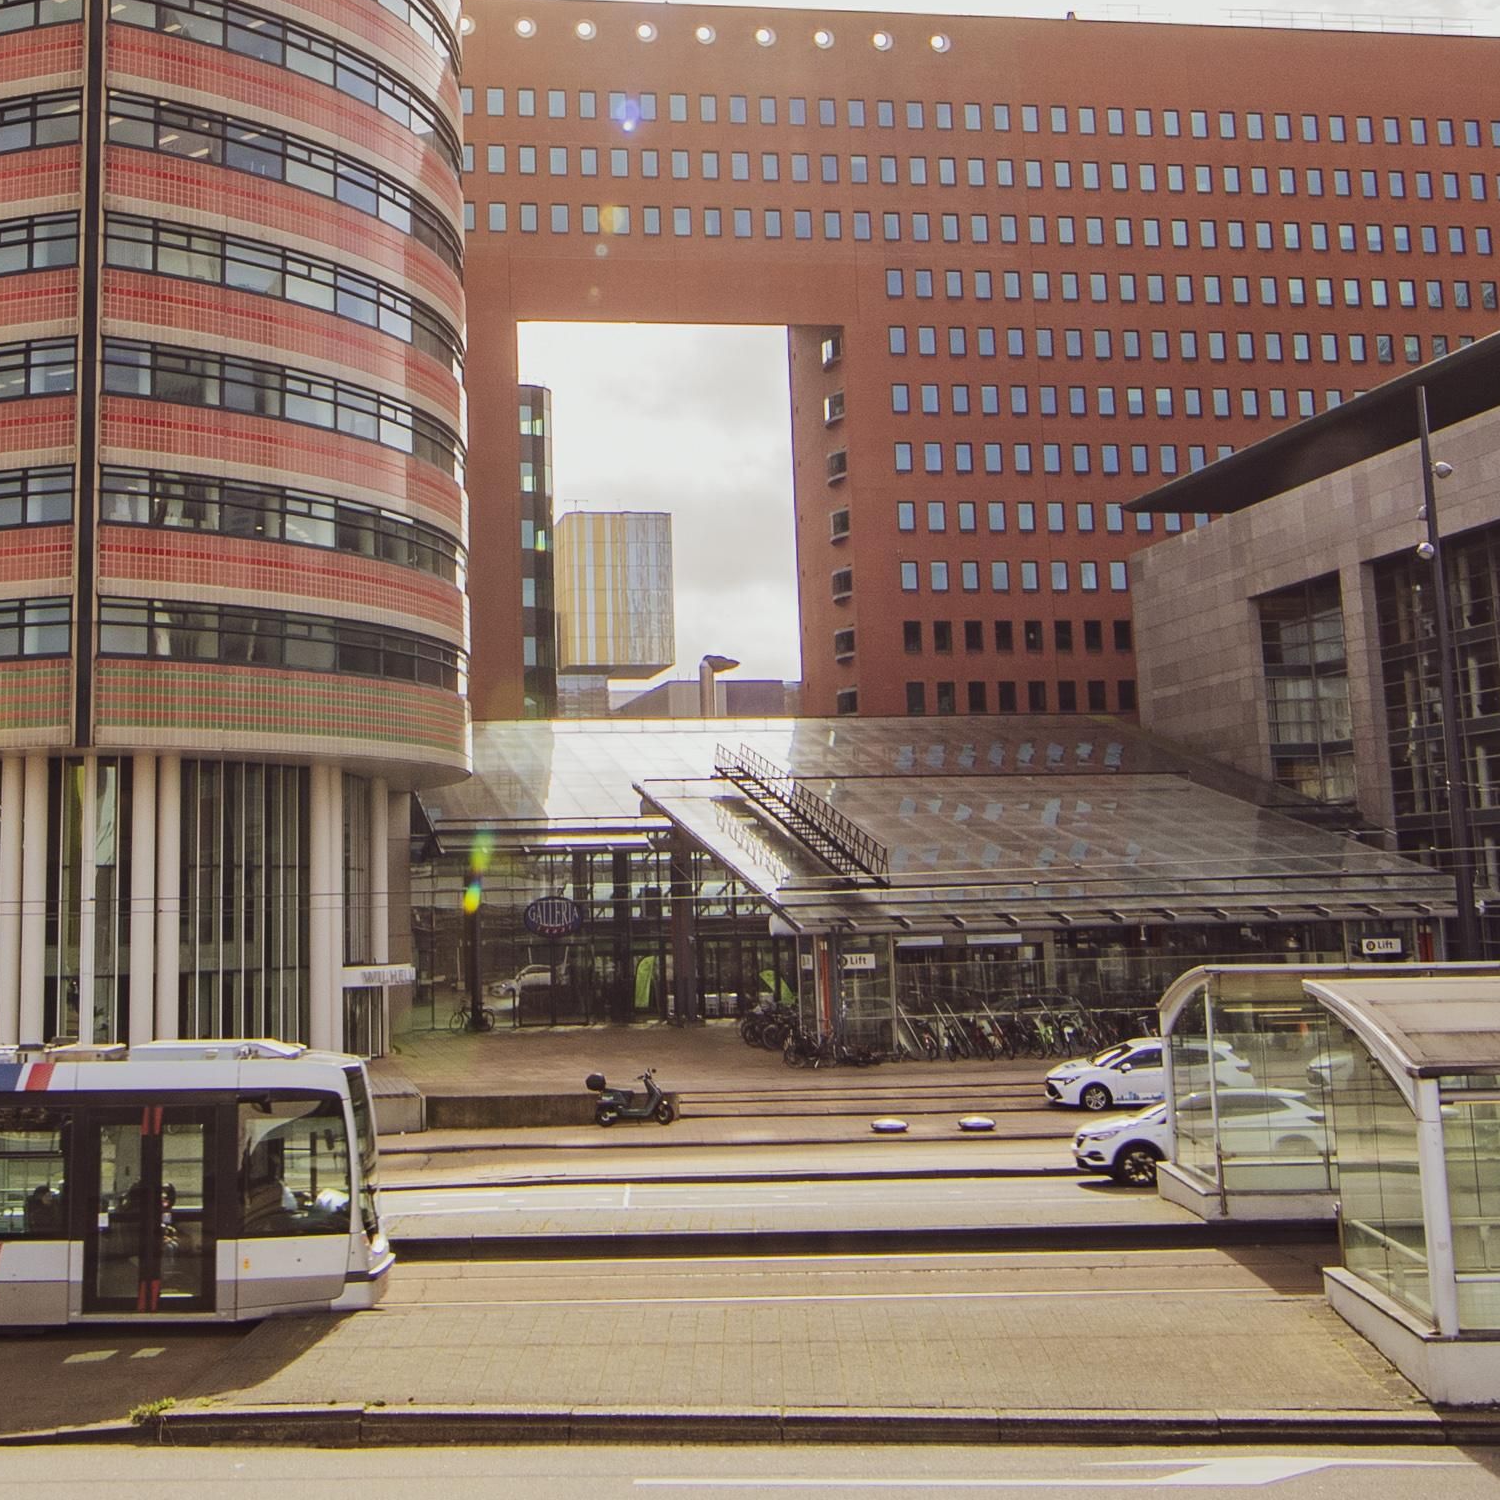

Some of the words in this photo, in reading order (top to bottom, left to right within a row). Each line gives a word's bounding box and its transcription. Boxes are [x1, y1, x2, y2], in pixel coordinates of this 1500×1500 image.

[528, 899, 579, 927] GALLERIA
[1377, 941, 1393, 949] Lift
[850, 956, 867, 965] Lift
